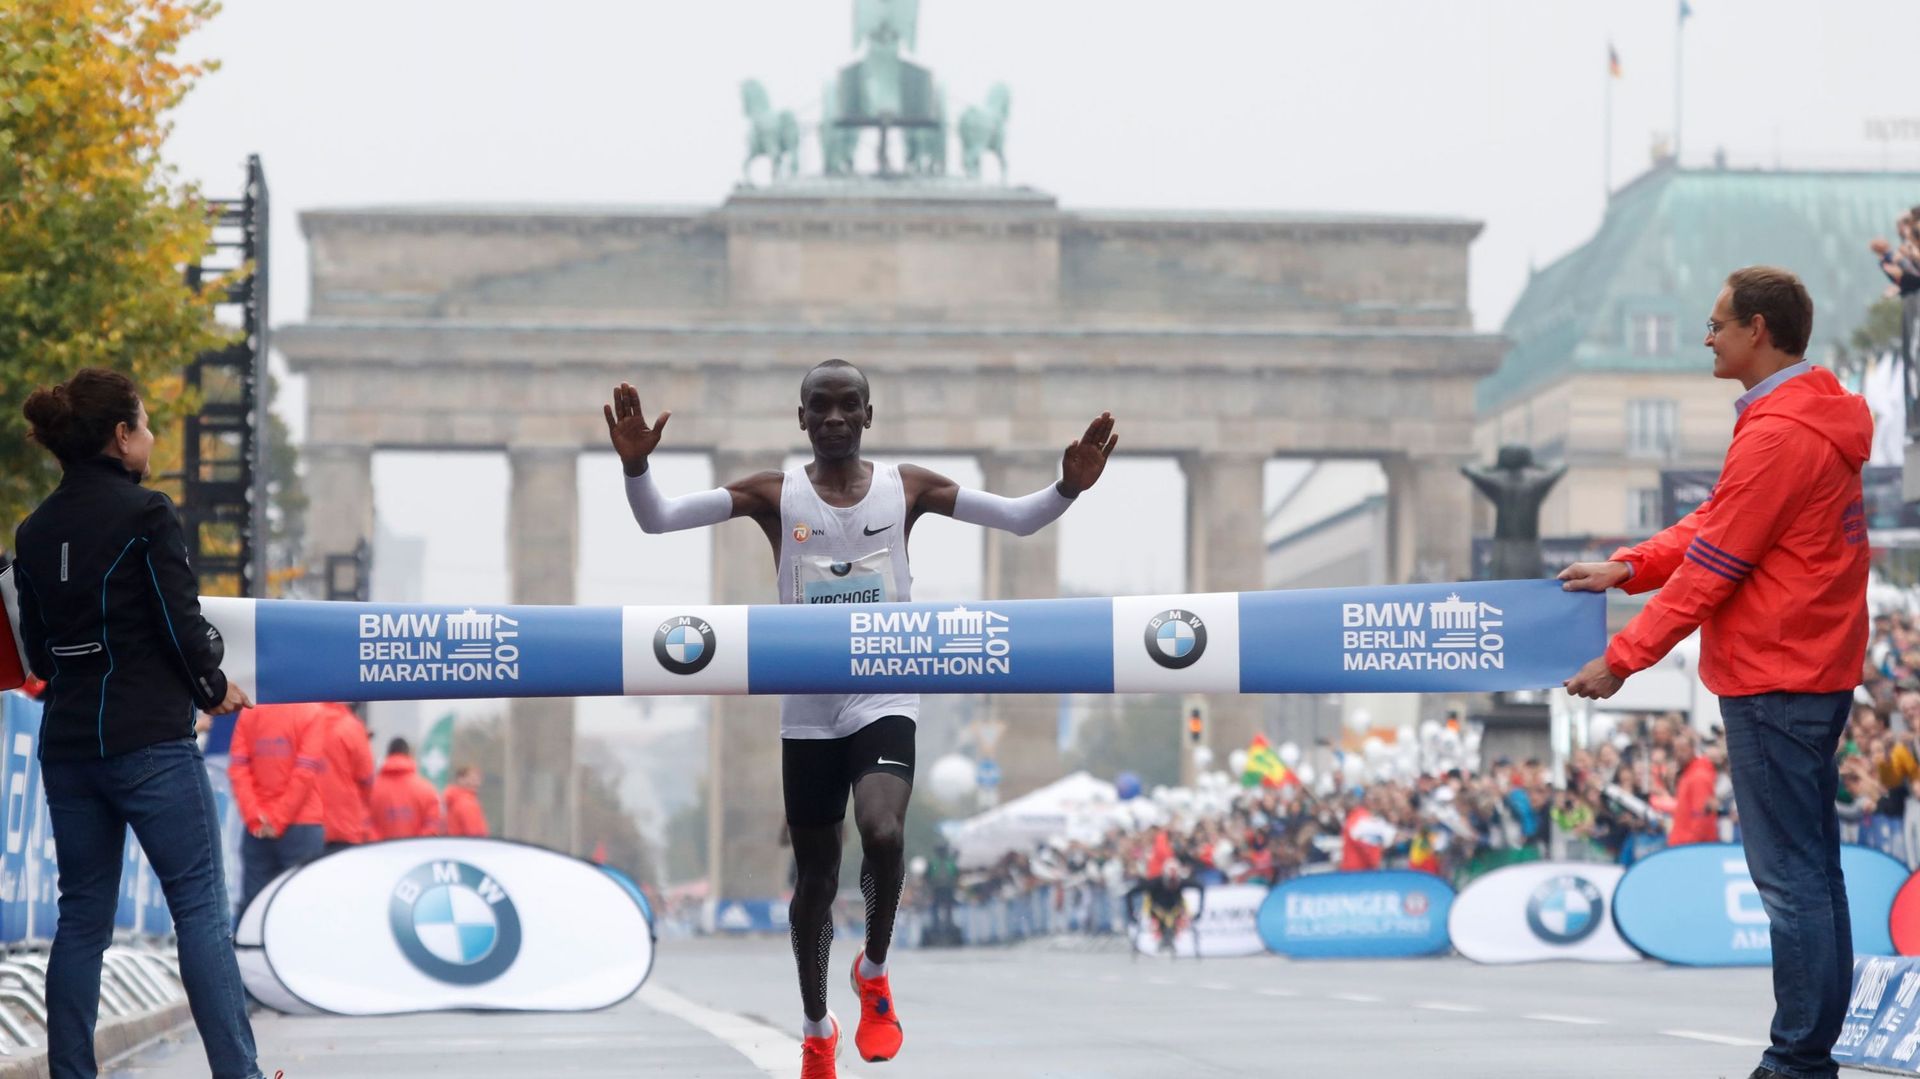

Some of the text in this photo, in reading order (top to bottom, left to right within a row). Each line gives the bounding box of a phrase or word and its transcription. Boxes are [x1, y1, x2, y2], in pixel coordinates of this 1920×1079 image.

[359, 613, 441, 638] BMW
[851, 611, 931, 633] BMW
[1343, 602, 1425, 628] BMW
[851, 636, 932, 654] BERLIN
[986, 611, 1010, 674] 2017
[1343, 631, 1426, 649] BERLIN
[1480, 601, 1504, 669] 2017
[360, 642, 441, 660] BERLIN
[495, 614, 519, 680] 2017
[360, 663, 492, 682] MARATHON
[851, 657, 983, 676] MARATHON
[1343, 652, 1478, 671] MARATHON
[396, 861, 506, 905] BMW
[1286, 892, 1399, 916] ERDINGER
